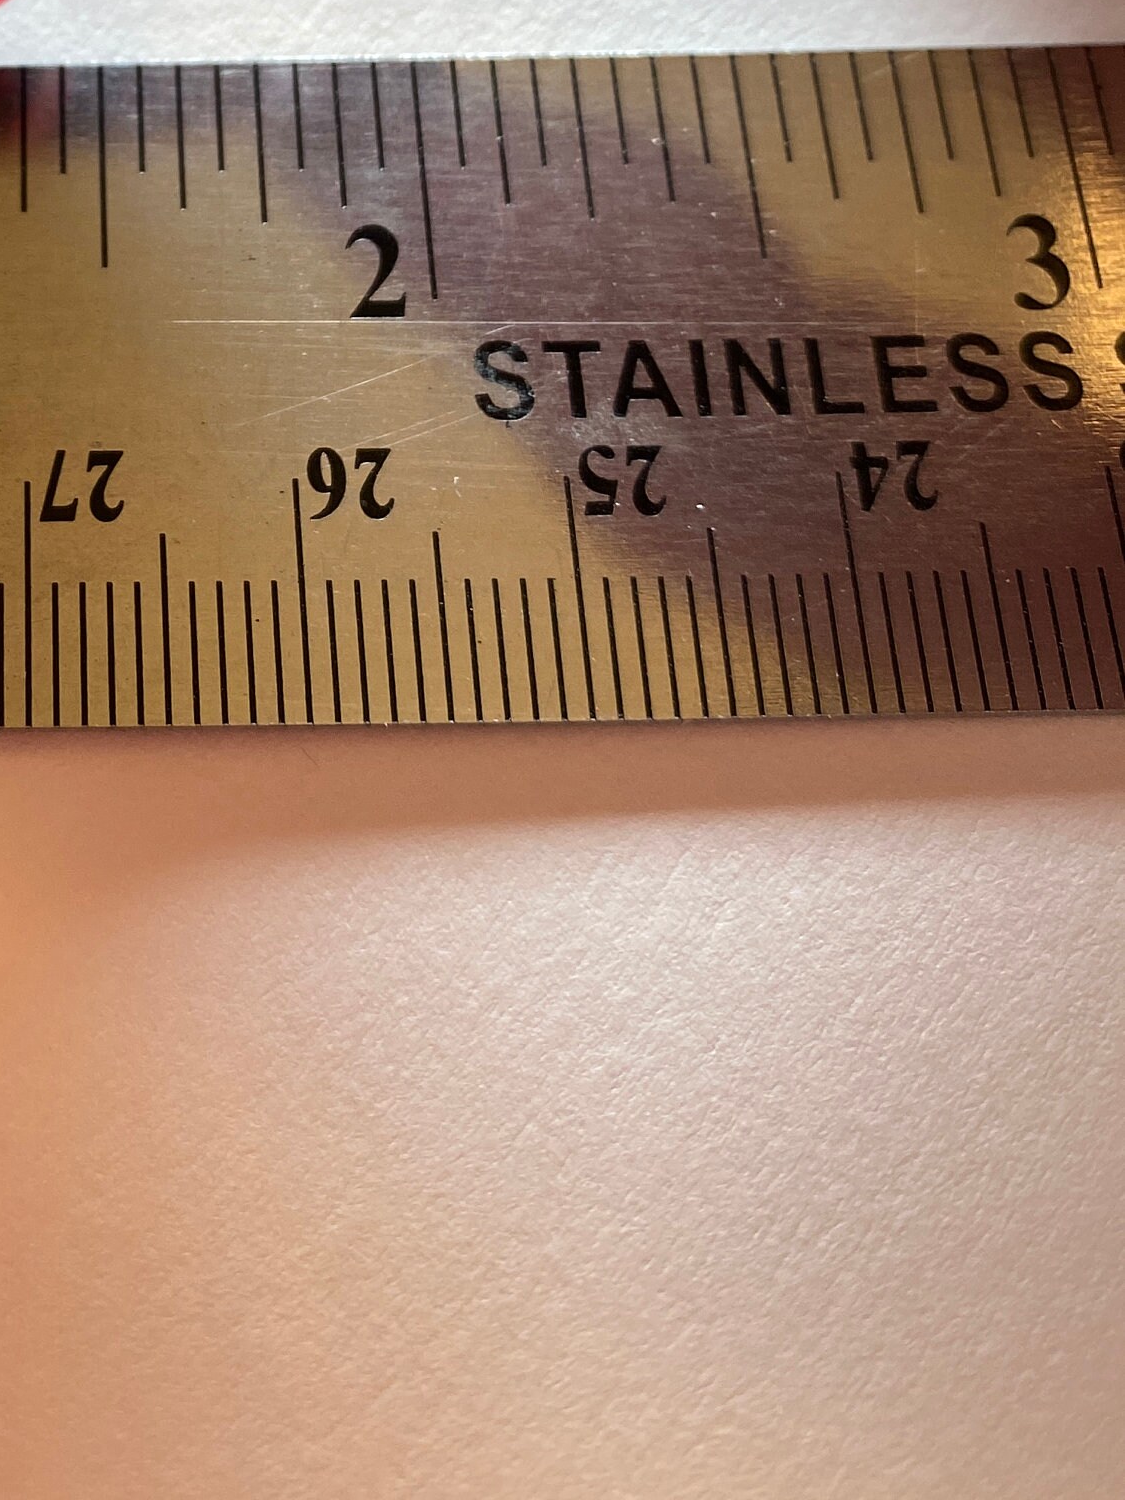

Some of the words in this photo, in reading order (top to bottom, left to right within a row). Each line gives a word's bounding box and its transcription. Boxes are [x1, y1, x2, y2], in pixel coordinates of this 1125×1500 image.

[345, 224, 407, 318] 2
[1006, 213, 1071, 310] 3
[474, 331, 1084, 420] STAINLESS
[38, 449, 125, 523] 27
[306, 447, 396, 520] 26
[577, 444, 666, 516] 25
[849, 439, 939, 512] 24
